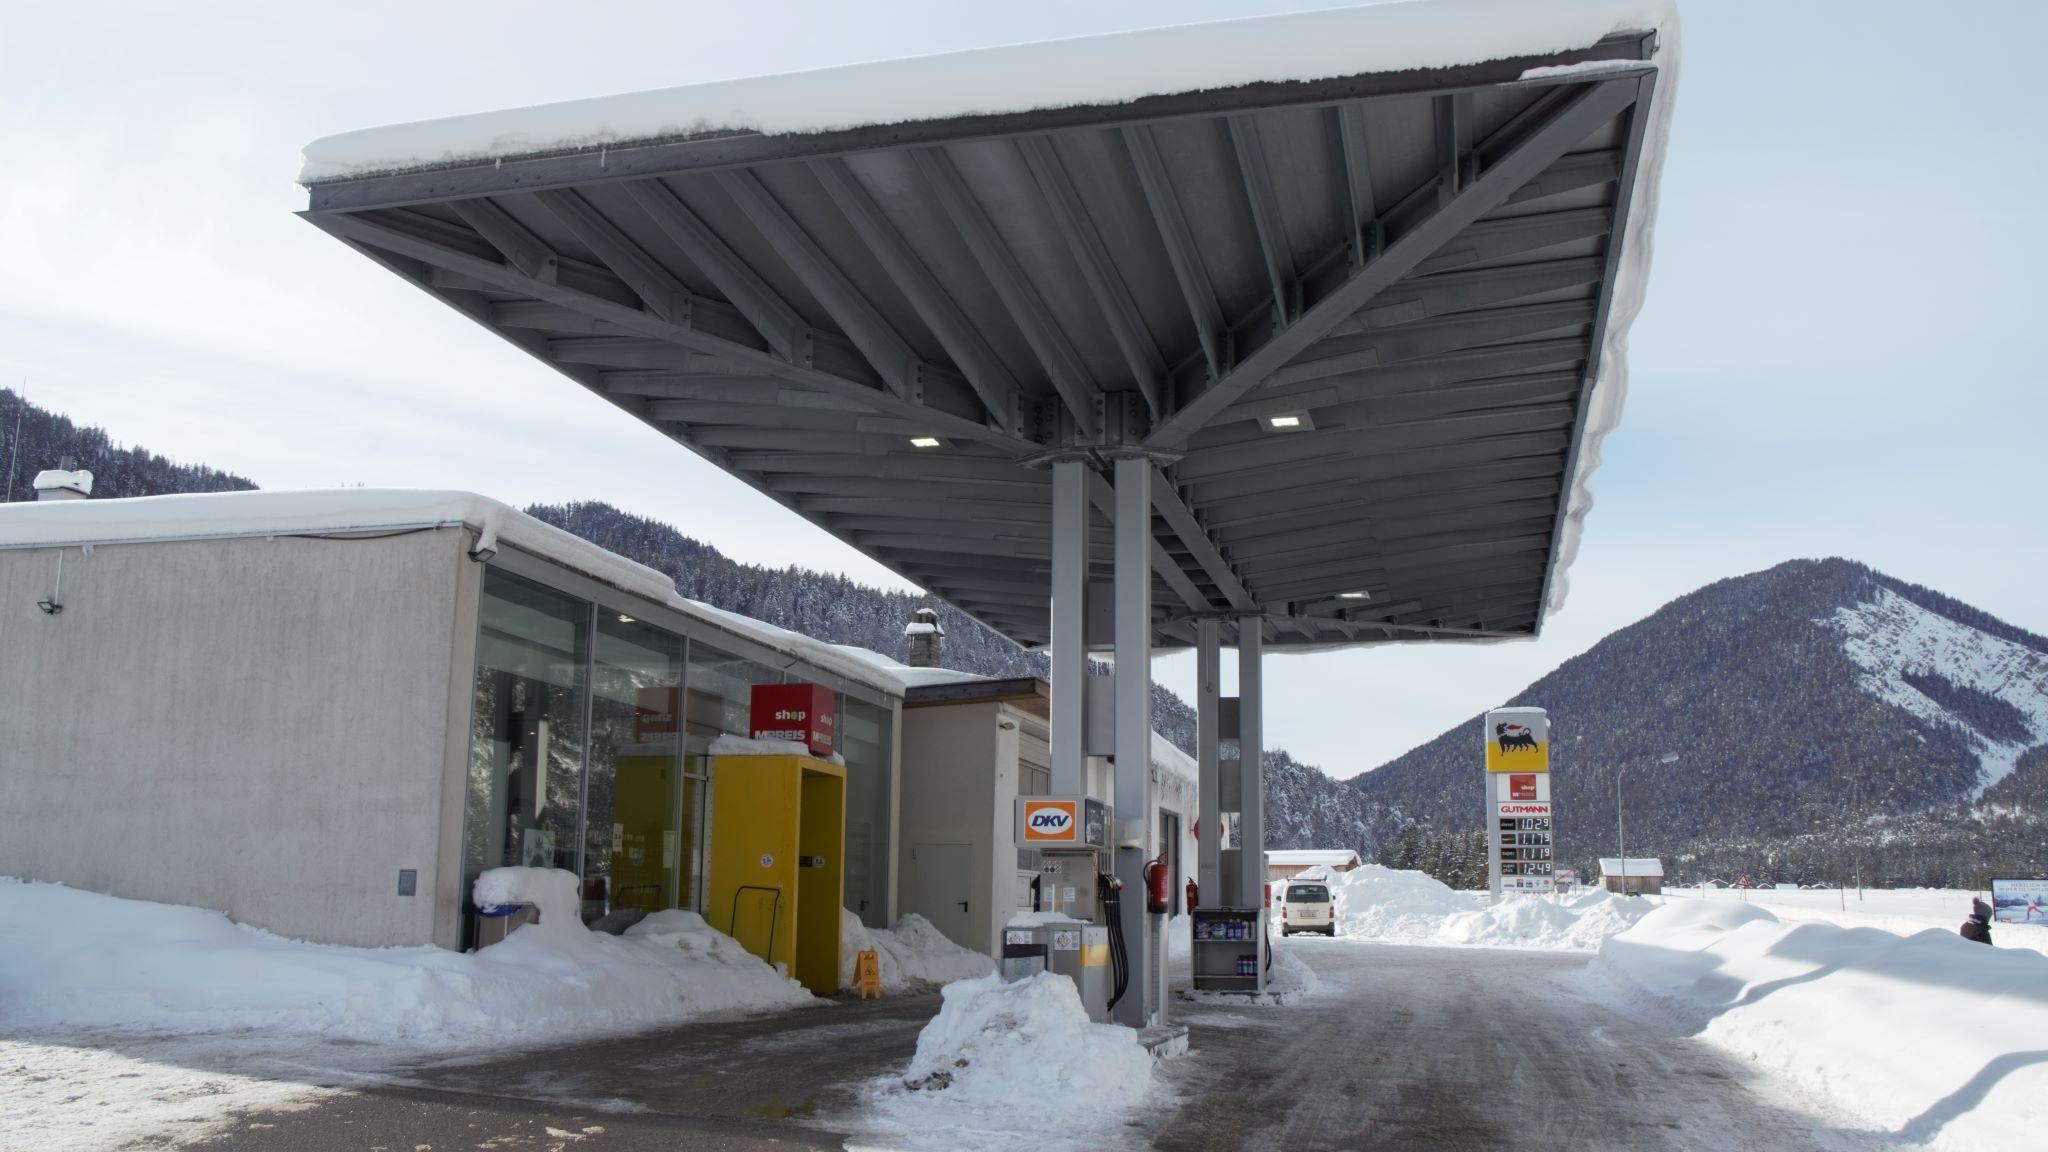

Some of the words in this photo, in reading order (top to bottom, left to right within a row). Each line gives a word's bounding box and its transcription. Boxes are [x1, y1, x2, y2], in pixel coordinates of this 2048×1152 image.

[775, 709, 806, 721] shop
[820, 714, 833, 727] shop
[754, 730, 806, 740] MPREIS
[1032, 815, 1069, 827] DKV
